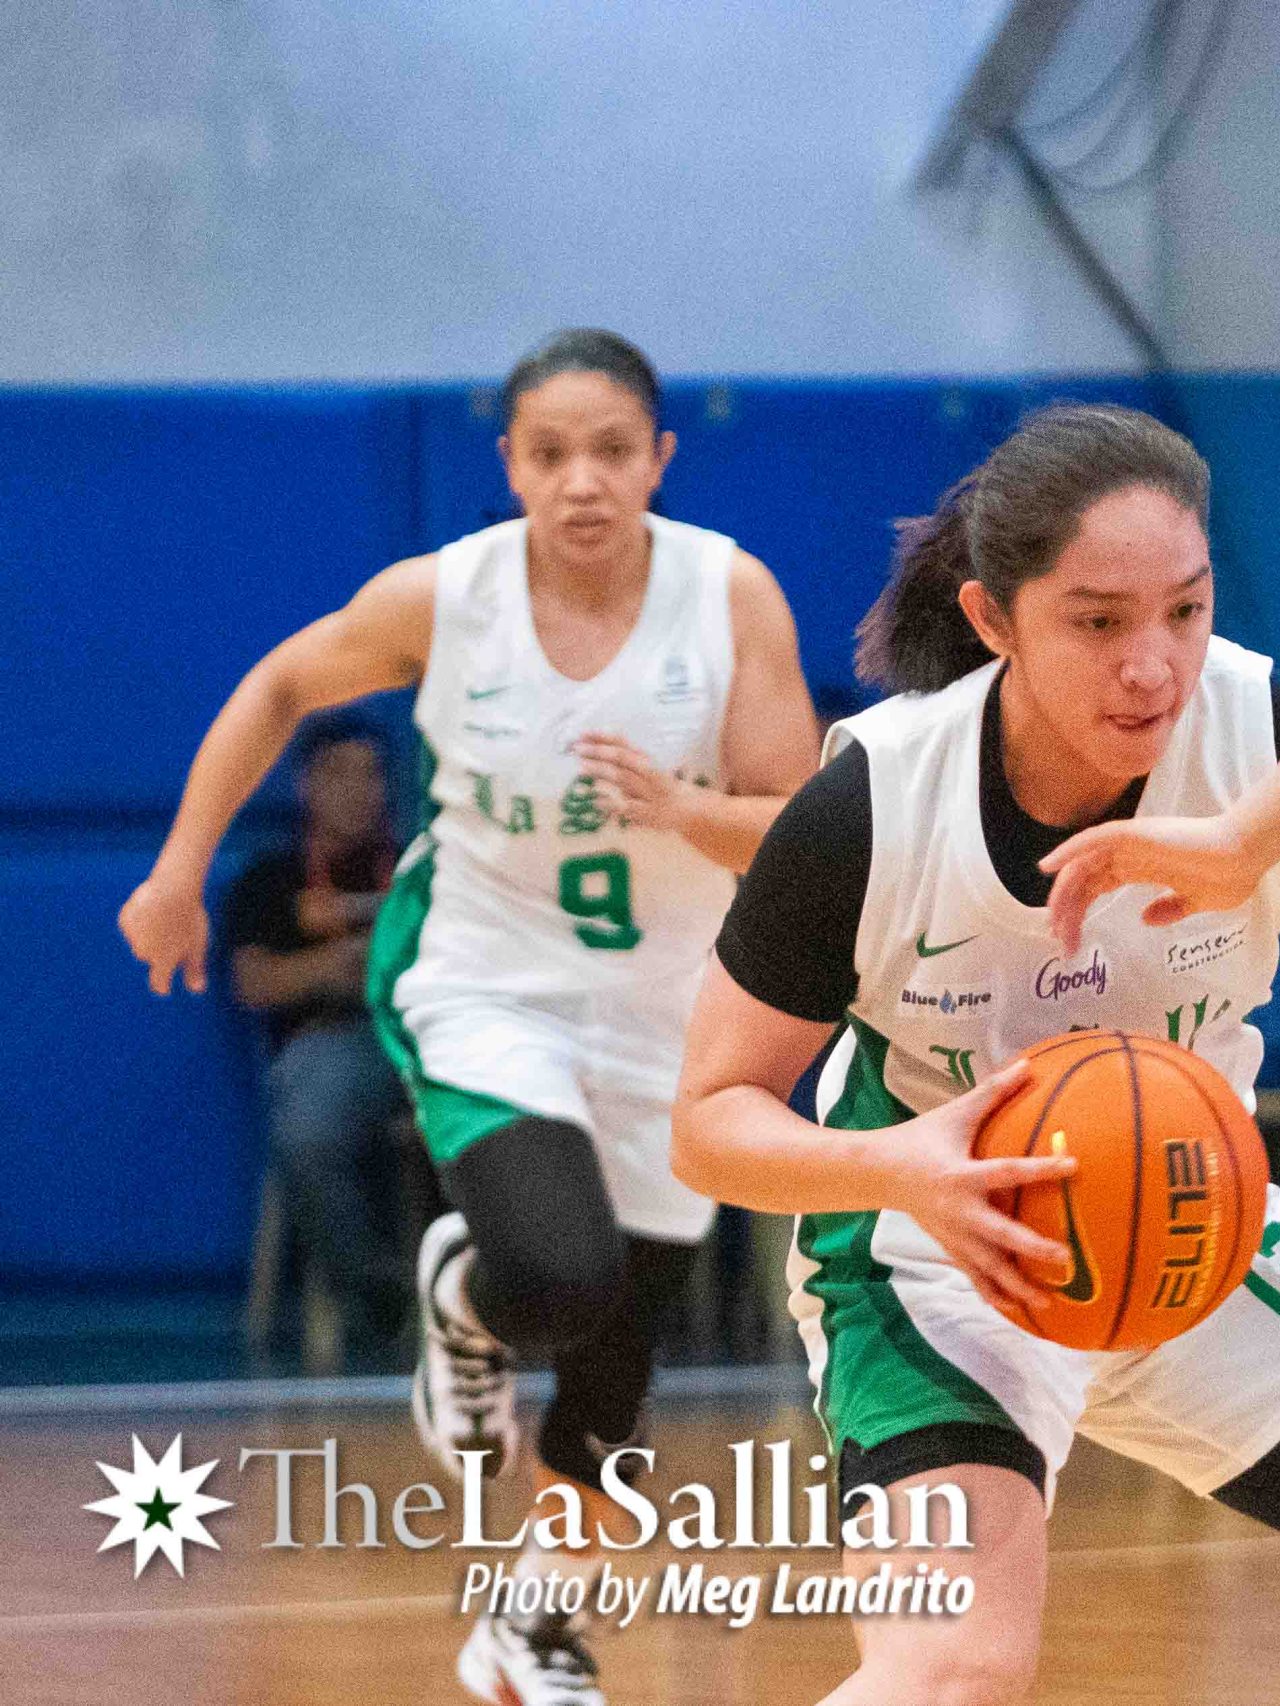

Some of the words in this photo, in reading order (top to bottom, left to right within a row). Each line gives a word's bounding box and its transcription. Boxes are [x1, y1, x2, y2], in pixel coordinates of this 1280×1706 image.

[558, 850, 645, 950] 9
[901, 988, 939, 1006] Blue
[957, 991, 992, 1007] Fire
[1035, 949, 1107, 1001] Goody
[1150, 1139, 1207, 1309] ELITE
